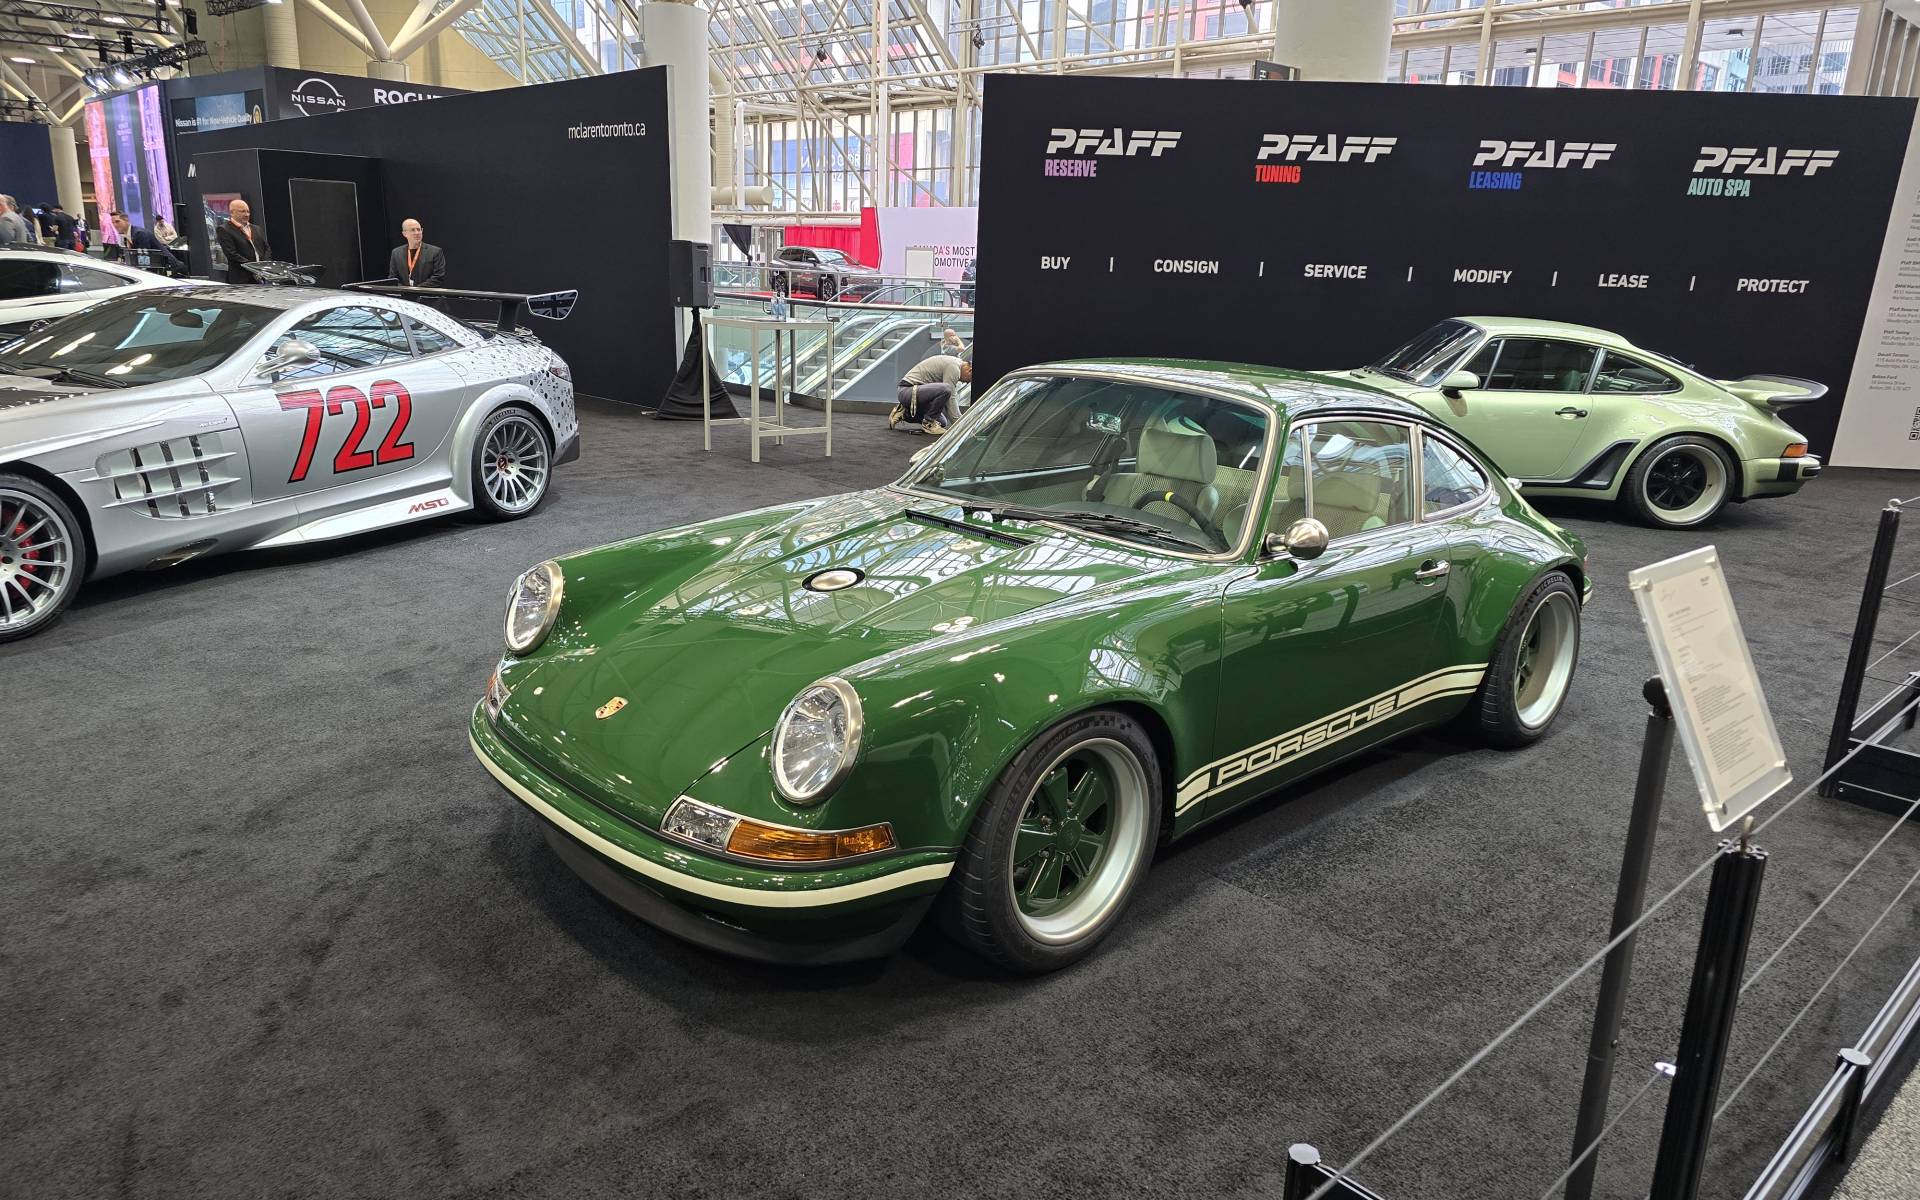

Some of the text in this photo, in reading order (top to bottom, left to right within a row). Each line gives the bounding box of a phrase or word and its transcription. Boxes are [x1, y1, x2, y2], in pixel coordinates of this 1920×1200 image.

[291, 93, 346, 107] NISSAN
[373, 88, 441, 105] ROG
[568, 121, 646, 140] mclarentoronto.ca
[1046, 128, 1182, 157] PFAFF
[1257, 133, 1398, 163] PFAFF
[1473, 139, 1618, 169] PFAFF
[1692, 146, 1841, 176] PFAFF
[1044, 158, 1098, 178] RESERVE
[1254, 164, 1302, 184] TUNING
[1468, 171, 1523, 190] LEASING
[1686, 178, 1751, 198] AUTO SPA
[952, 246, 975, 256] MOST
[1040, 256, 1810, 294] BUY CONSIGN SERVICE MODIFY LEASE PROTECT
[275, 379, 415, 484] 722
[1216, 694, 1397, 786] PORSCHE
